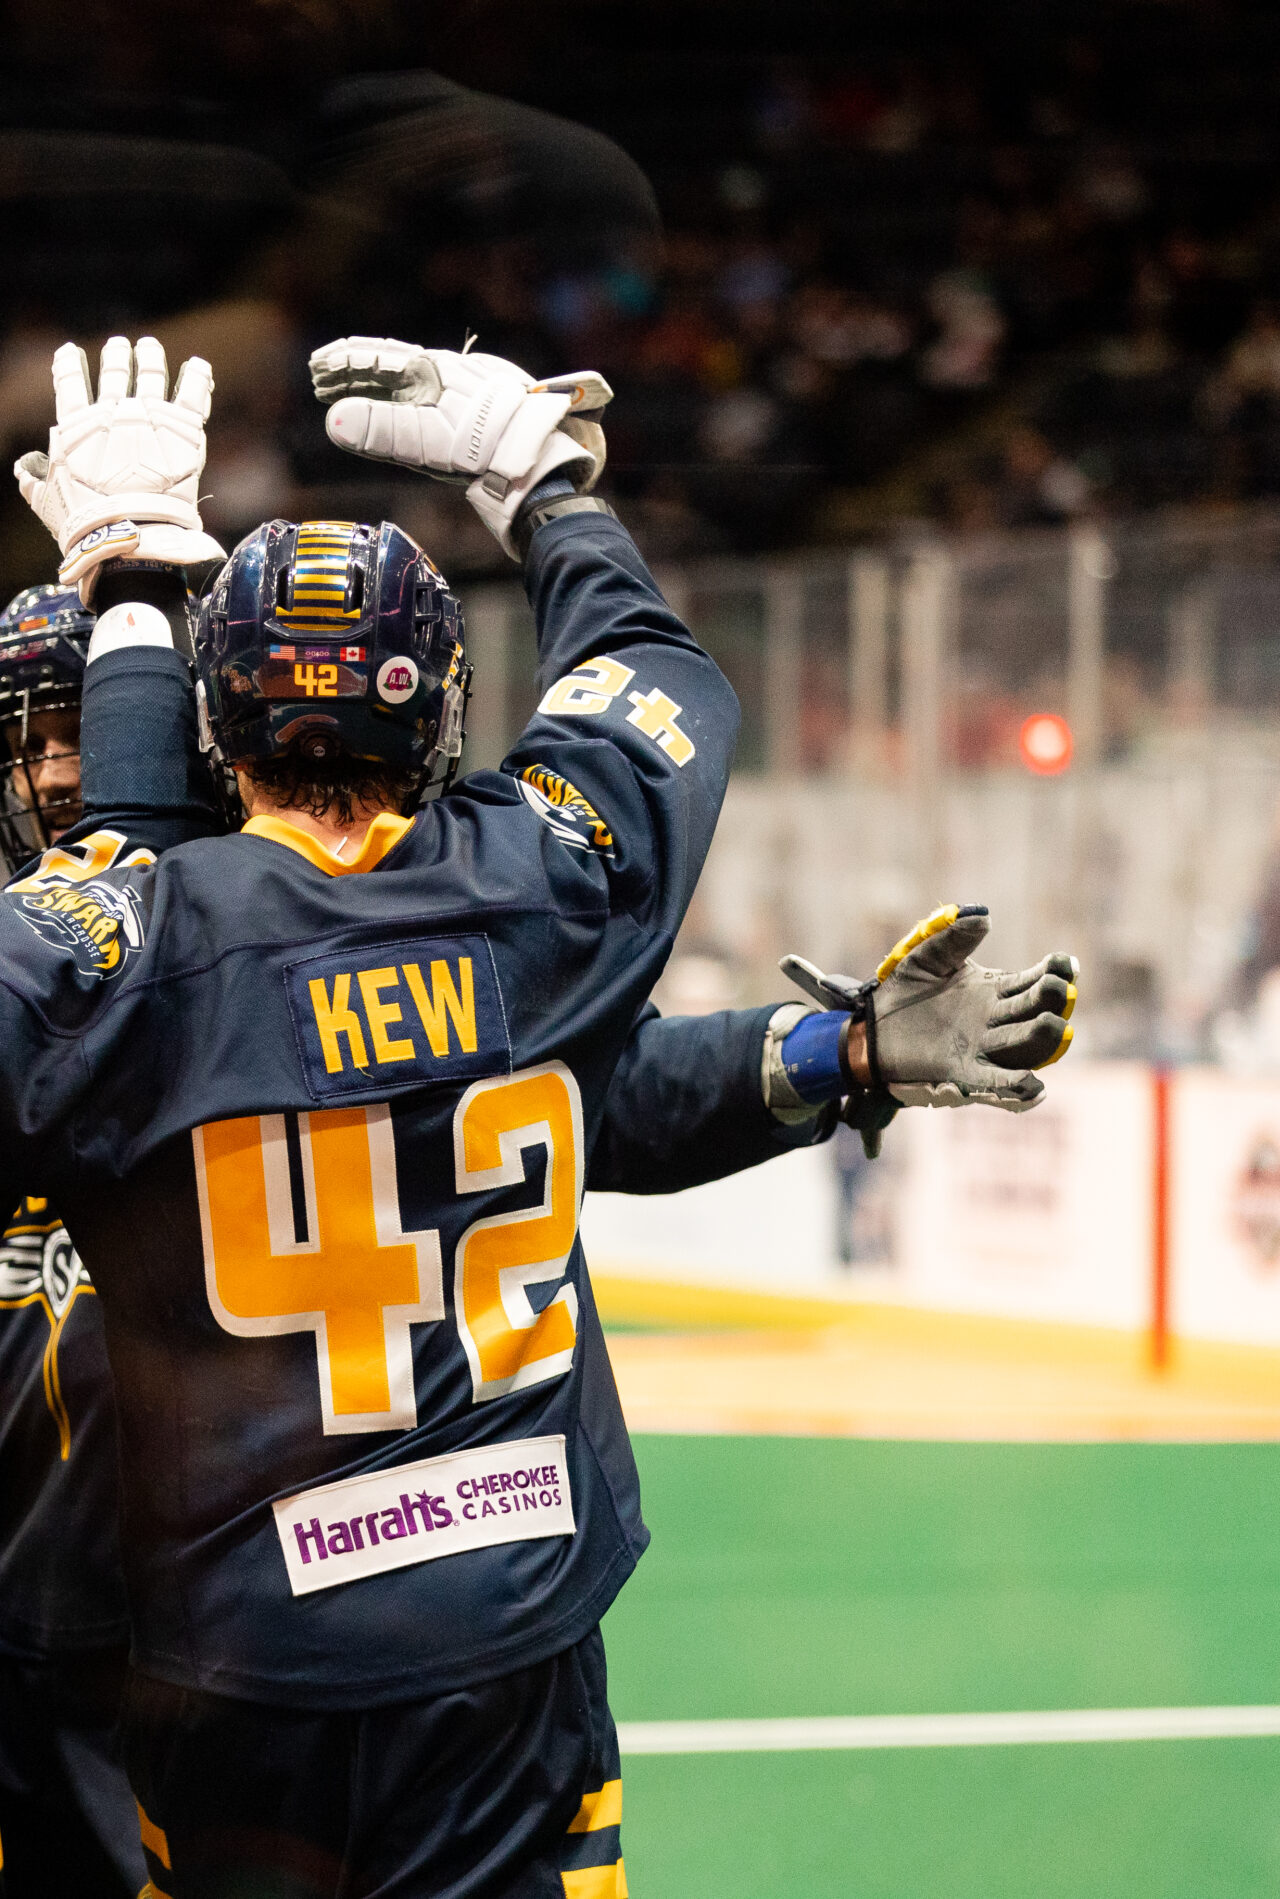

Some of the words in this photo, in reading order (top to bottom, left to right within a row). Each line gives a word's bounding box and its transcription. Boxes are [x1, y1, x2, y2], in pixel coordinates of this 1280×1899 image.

[294, 663, 338, 697] 42
[389, 673, 409, 686] A.W.
[537, 656, 696, 768] 42
[60, 912, 100, 958] LACROSSE
[308, 956, 478, 1074] KEW
[191, 1059, 585, 1436] 42
[456, 1465, 560, 1500] CHEROKEE
[462, 1488, 562, 1520] CASINOS
[293, 1490, 454, 1564] Harrah's
